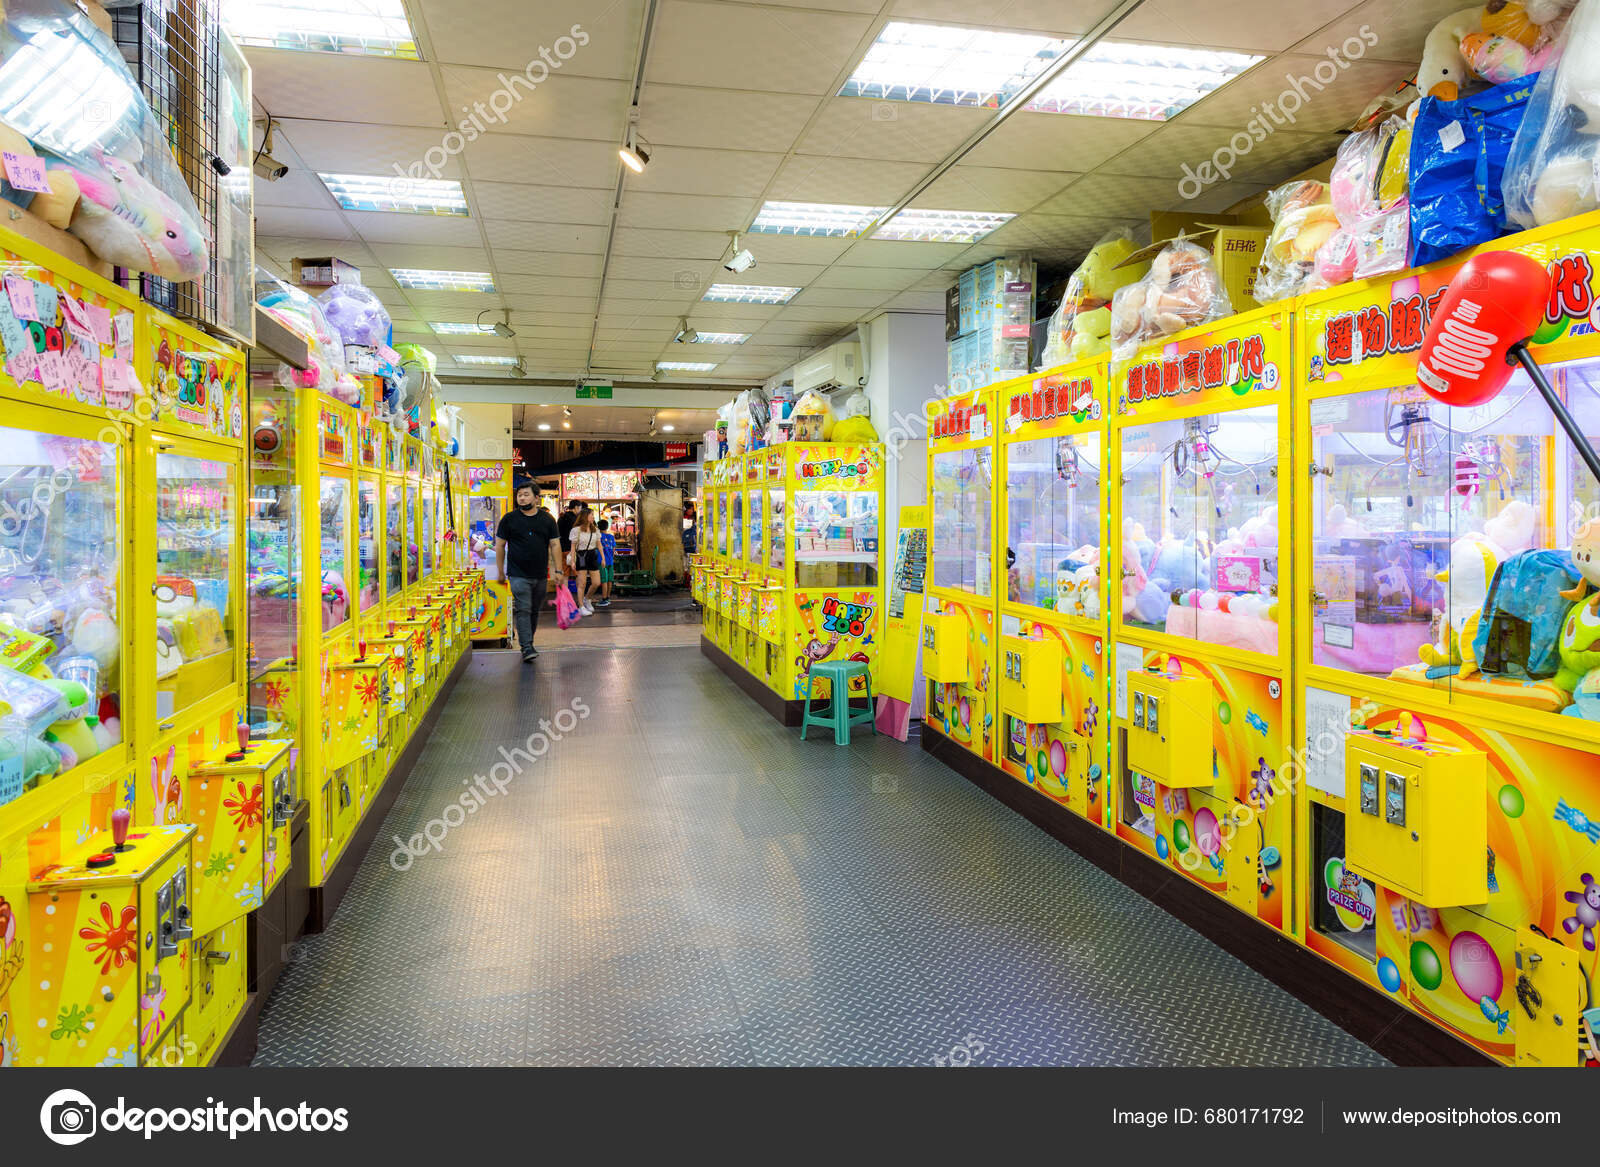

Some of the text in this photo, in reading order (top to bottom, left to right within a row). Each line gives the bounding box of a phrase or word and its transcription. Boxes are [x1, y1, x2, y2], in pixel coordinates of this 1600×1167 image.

[1504, 87, 1532, 104] IK
[1224, 239, 1257, 253] 五月花
[1429, 318, 1499, 380] 1000
[174, 347, 208, 383] HAPPY
[1263, 368, 1276, 384] 13
[178, 376, 207, 407] ZOO
[467, 466, 504, 481] TORY
[802, 459, 869, 478] HAPPY ZOO
[821, 597, 873, 622] HAPPY
[821, 614, 866, 638] ZOO
[1330, 889, 1371, 918] PRIZE OUT
